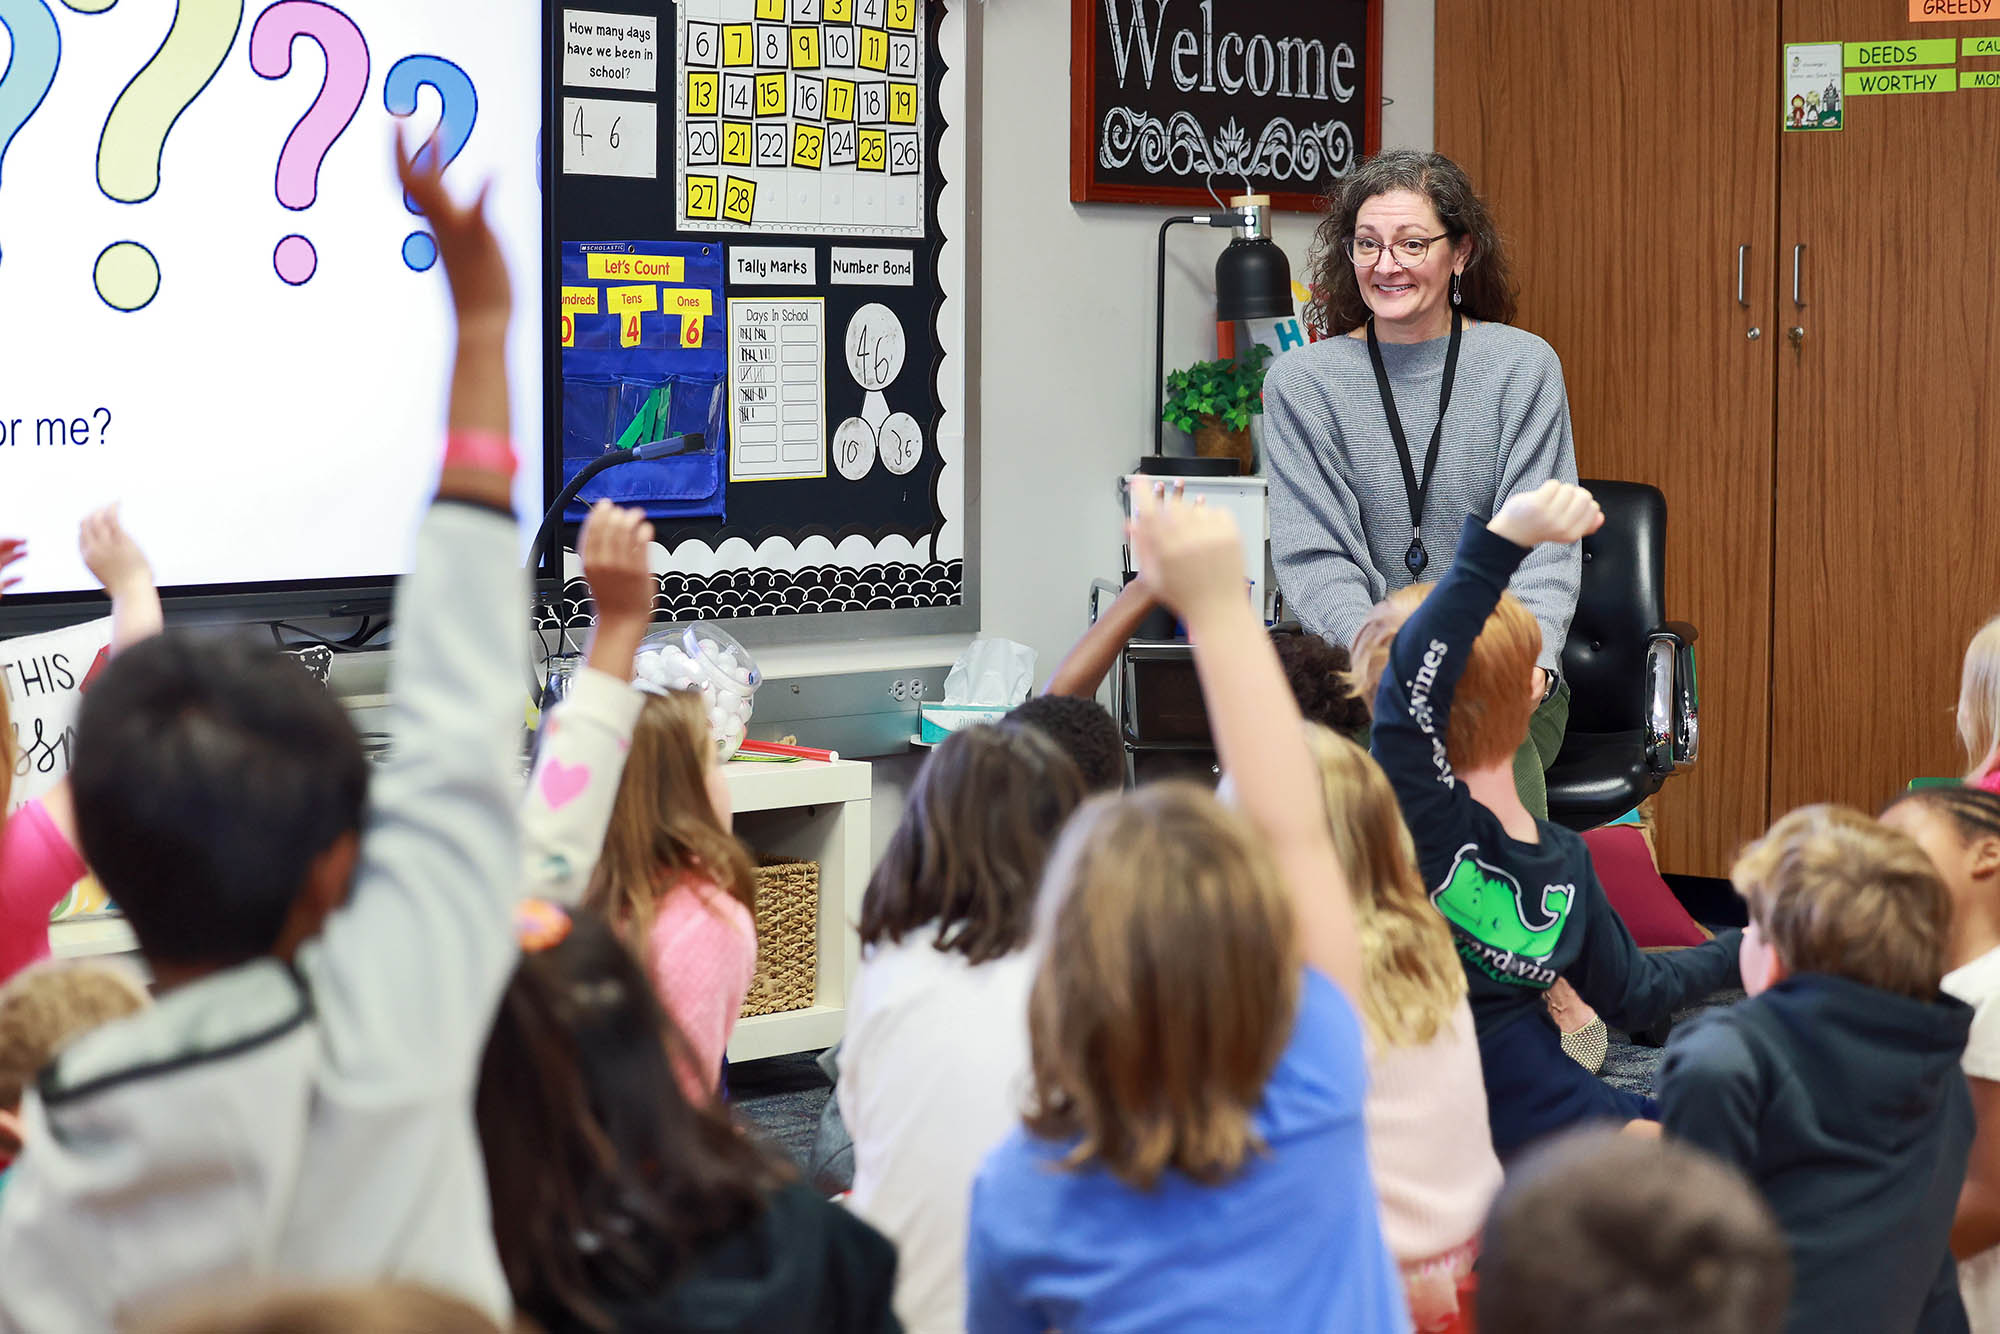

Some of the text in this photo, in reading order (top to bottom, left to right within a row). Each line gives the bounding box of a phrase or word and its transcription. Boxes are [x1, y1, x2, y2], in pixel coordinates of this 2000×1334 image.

[864, 0, 877, 20] 4
[895, 0, 908, 22] 5
[1923, 0, 1991, 15] GREEDY
[569, 22, 651, 43] How many days
[567, 41, 653, 60] have we been in
[696, 31, 911, 68] 6 7 8 9 10 11 12
[1103, 0, 1356, 103] Welcome
[1860, 46, 1917, 64] DEEDS
[589, 65, 631, 80] school?
[1860, 74, 1937, 92] WORTHY
[694, 81, 911, 116] 13 14 15 16 17 18 19
[690, 130, 917, 166] 20 21 22 23 24 25 26
[691, 184, 750, 214] 27 28
[605, 259, 670, 276] Let's Count
[737, 259, 808, 277] Tally Marks
[833, 260, 911, 275] Number Bond
[621, 294, 642, 304] Tens
[677, 296, 700, 307] Ones
[746, 309, 809, 324] Days In School
[626, 315, 639, 342] 4
[686, 318, 700, 345] 6
[857, 324, 889, 385] 46
[37, 407, 111, 446] me?
[841, 440, 859, 469] 10
[891, 429, 912, 466] 36
[1406, 638, 1449, 706] vines
